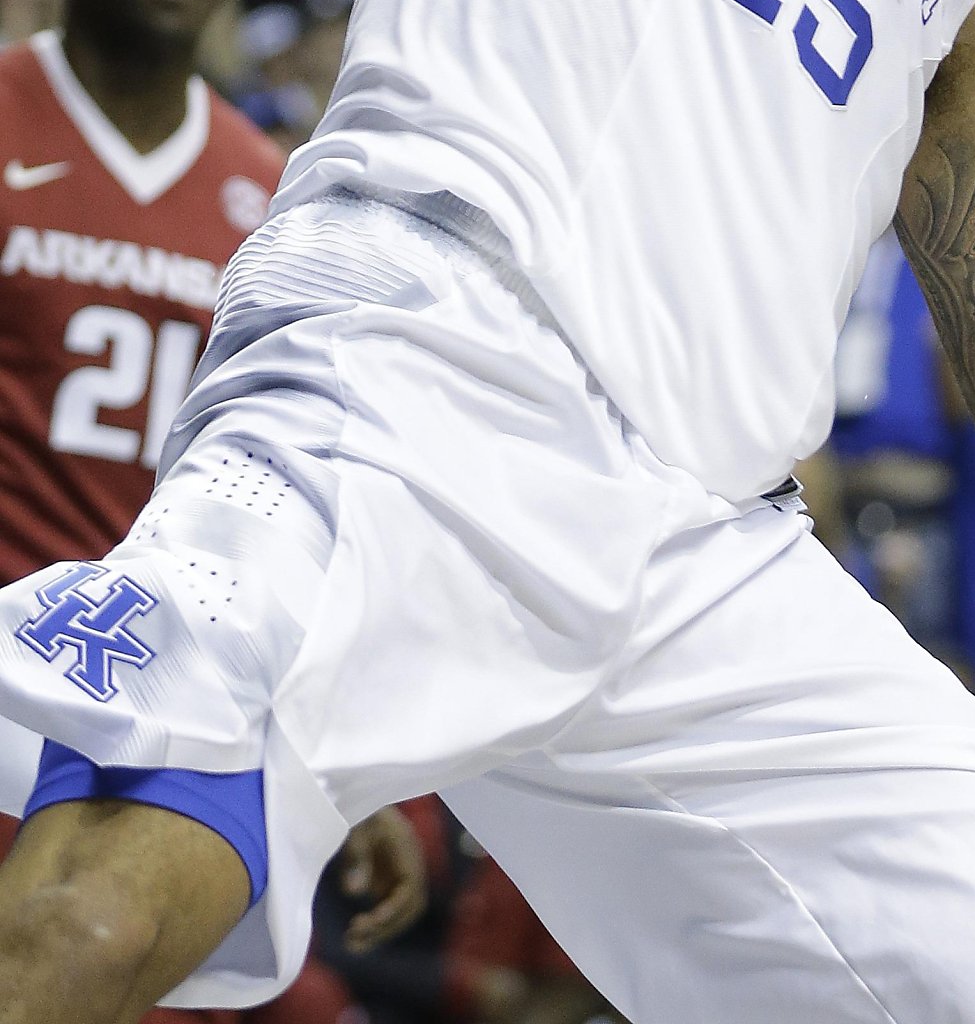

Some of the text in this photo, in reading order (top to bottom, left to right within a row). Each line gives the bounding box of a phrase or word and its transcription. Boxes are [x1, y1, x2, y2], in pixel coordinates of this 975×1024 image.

[0, 225, 222, 310] ARKANS
[50, 302, 202, 469] 21
[15, 560, 160, 703] UK
